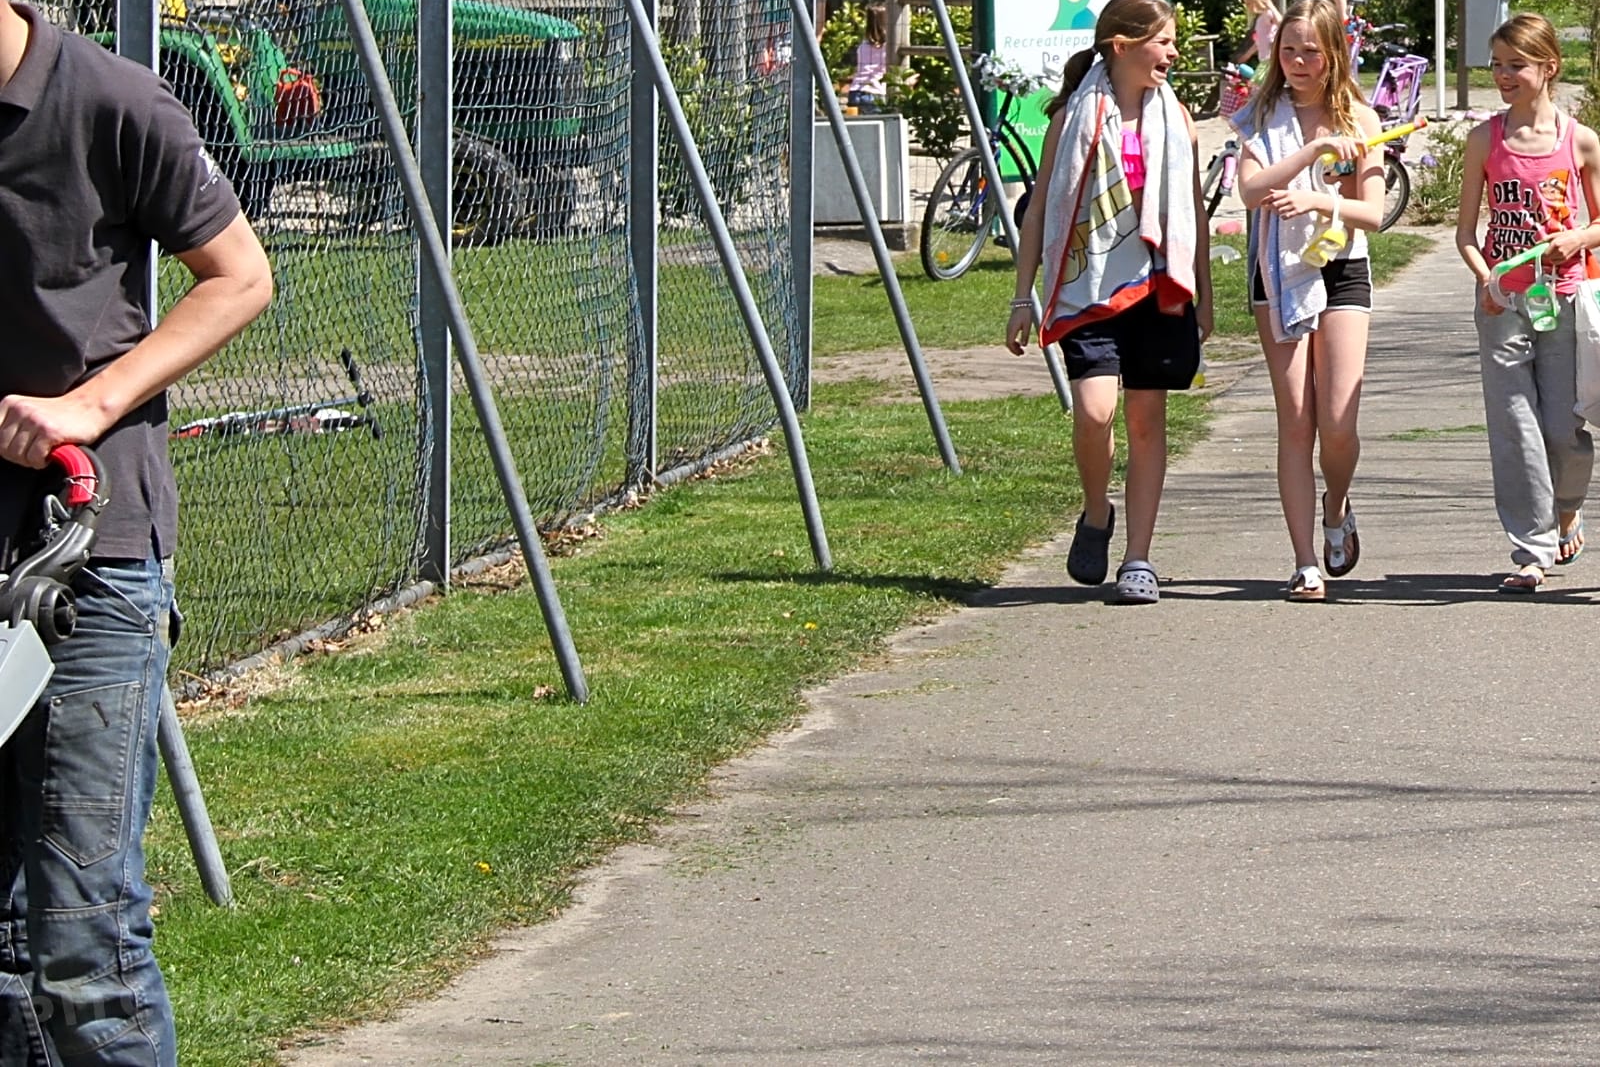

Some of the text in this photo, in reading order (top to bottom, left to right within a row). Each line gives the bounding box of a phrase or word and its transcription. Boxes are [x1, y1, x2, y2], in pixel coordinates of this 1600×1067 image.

[1004, 35, 1096, 49] Recreatiepar
[1042, 51, 1060, 64] De
[1493, 179, 1534, 208] OH I
[1489, 227, 1537, 246] THINK
